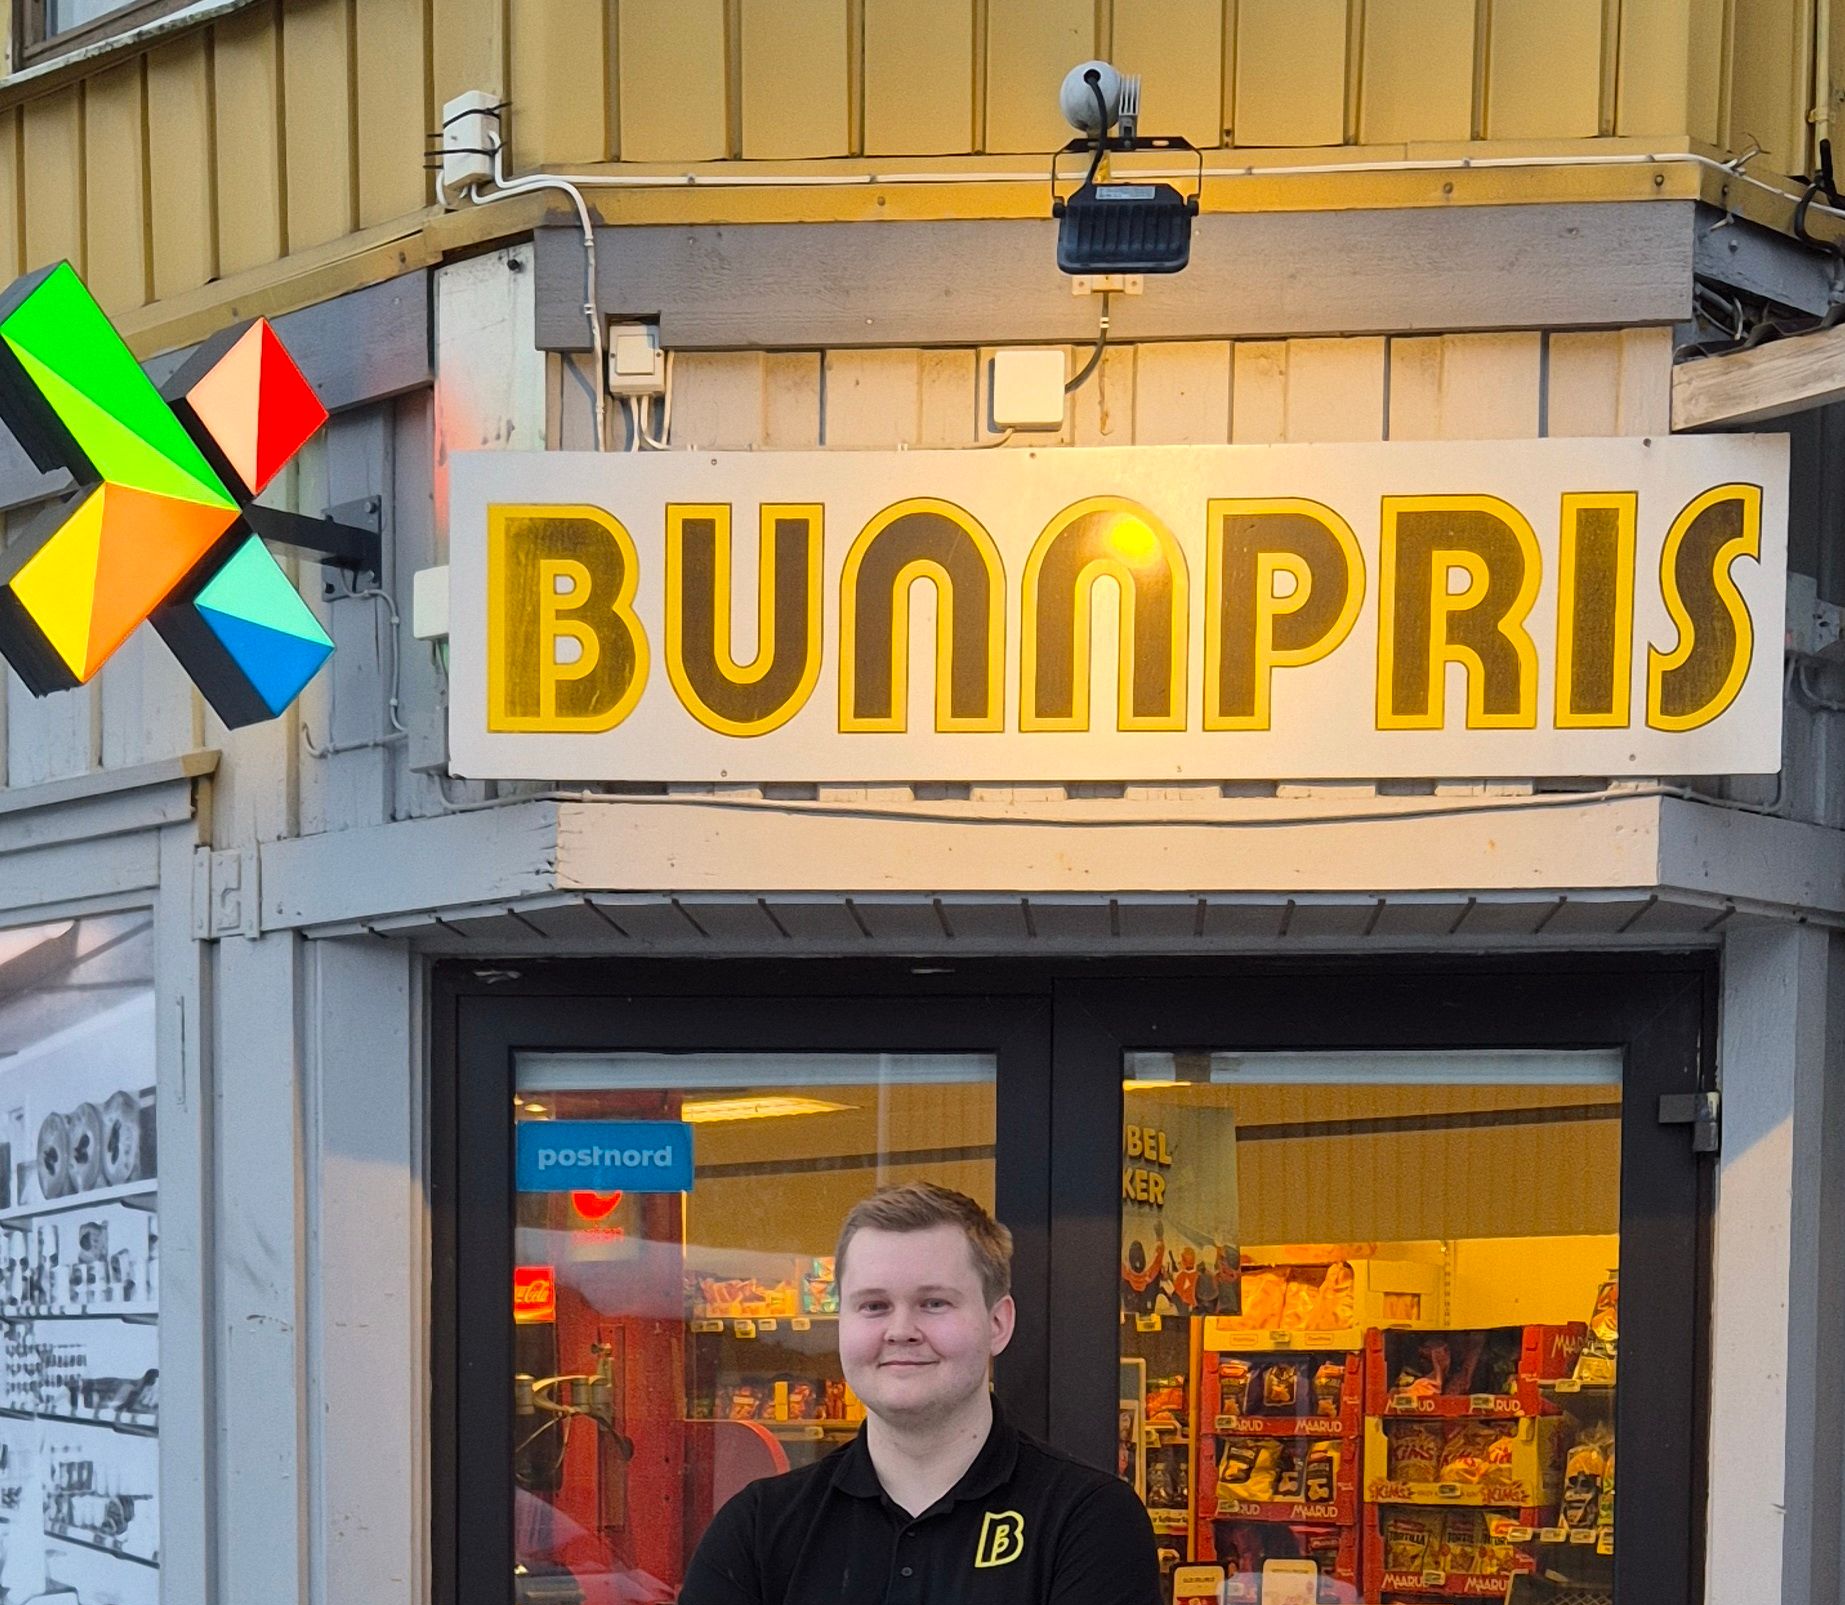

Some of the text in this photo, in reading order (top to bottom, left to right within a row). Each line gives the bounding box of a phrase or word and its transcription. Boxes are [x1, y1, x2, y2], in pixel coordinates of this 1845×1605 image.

[486, 481, 1762, 738] BUNNPRIS
[537, 1146, 673, 1171] postnord
[1294, 1420, 1343, 1435] MAARUD
[1290, 1504, 1339, 1520] MAARUD
[974, 1510, 1024, 1568] B
[1381, 1573, 1427, 1589] MAARU
